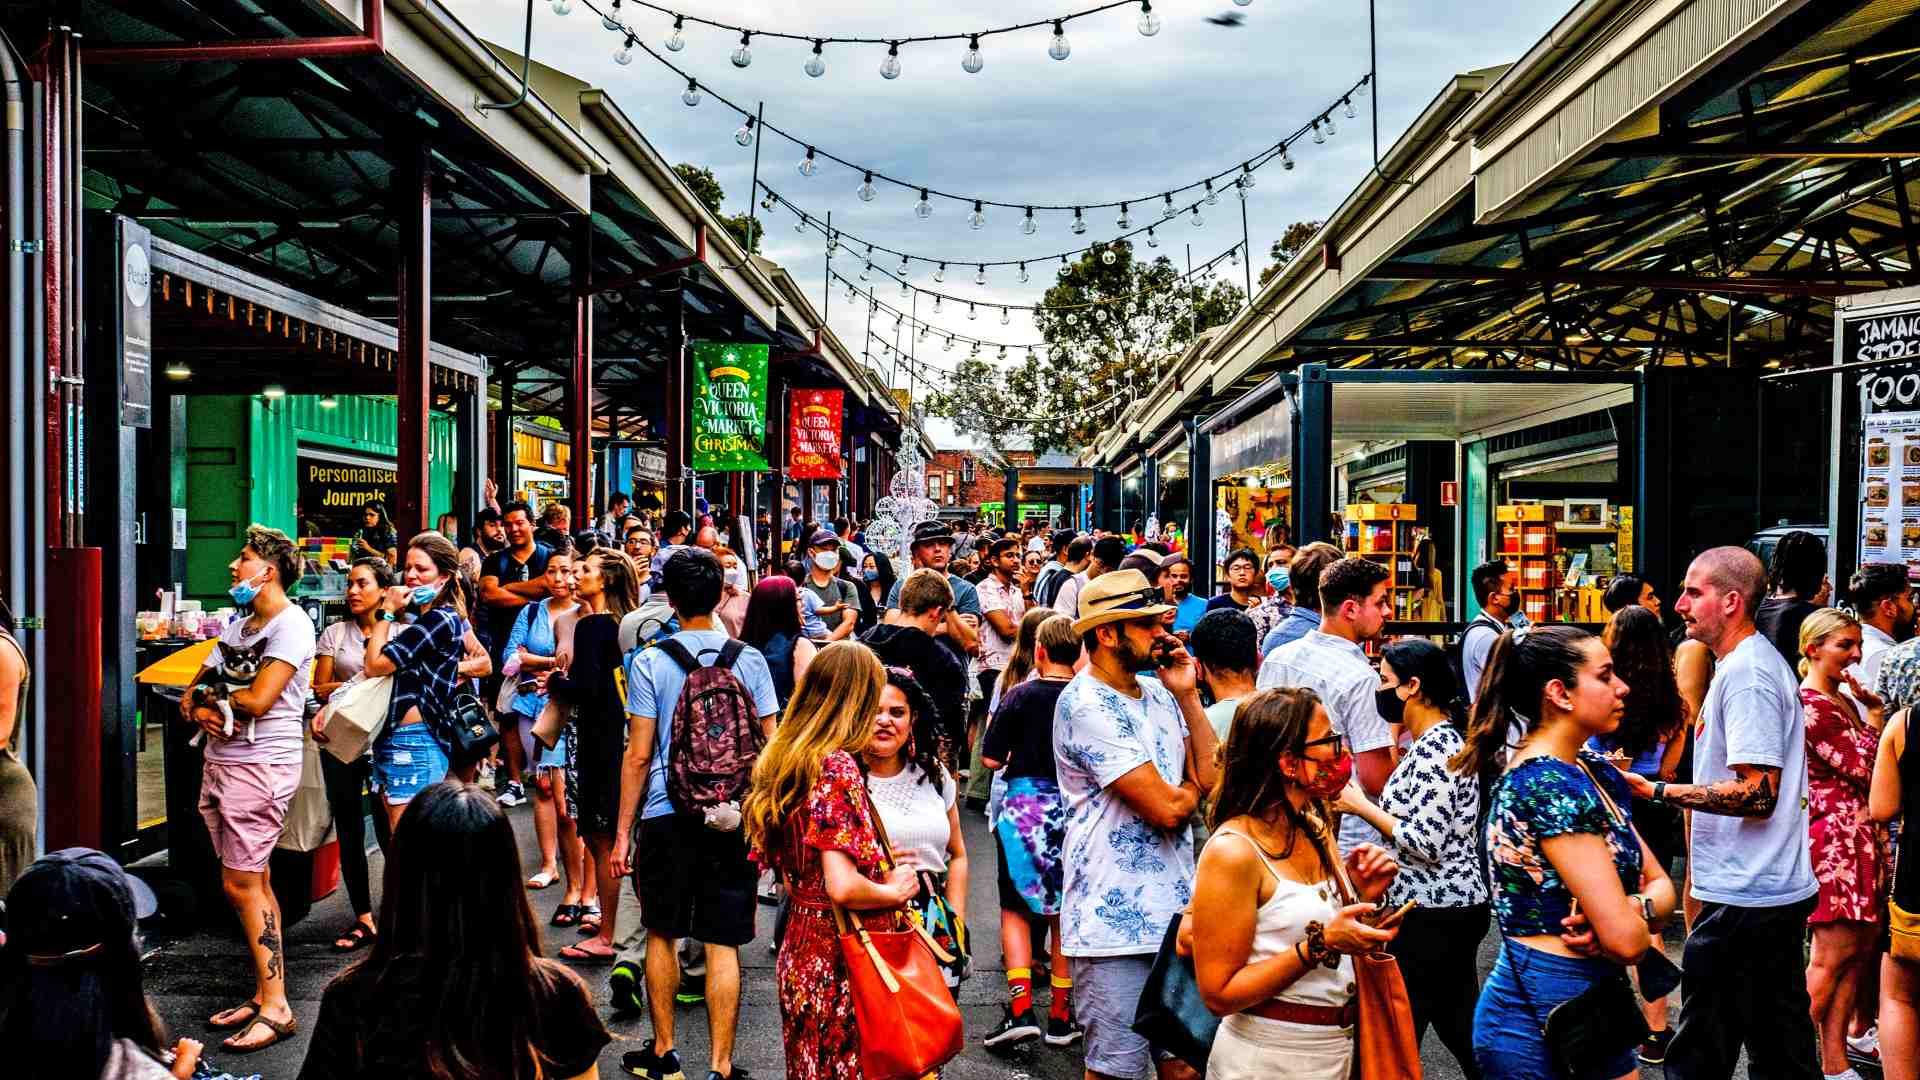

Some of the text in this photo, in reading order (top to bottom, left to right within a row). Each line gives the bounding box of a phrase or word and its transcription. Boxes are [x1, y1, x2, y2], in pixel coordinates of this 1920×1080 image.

[709, 381, 750, 400] QUEEN
[694, 397, 763, 425] VICTORIA
[702, 417, 756, 435] MARKET
[802, 415, 830, 429] QUEEN
[694, 433, 762, 454] CHRISTMAS
